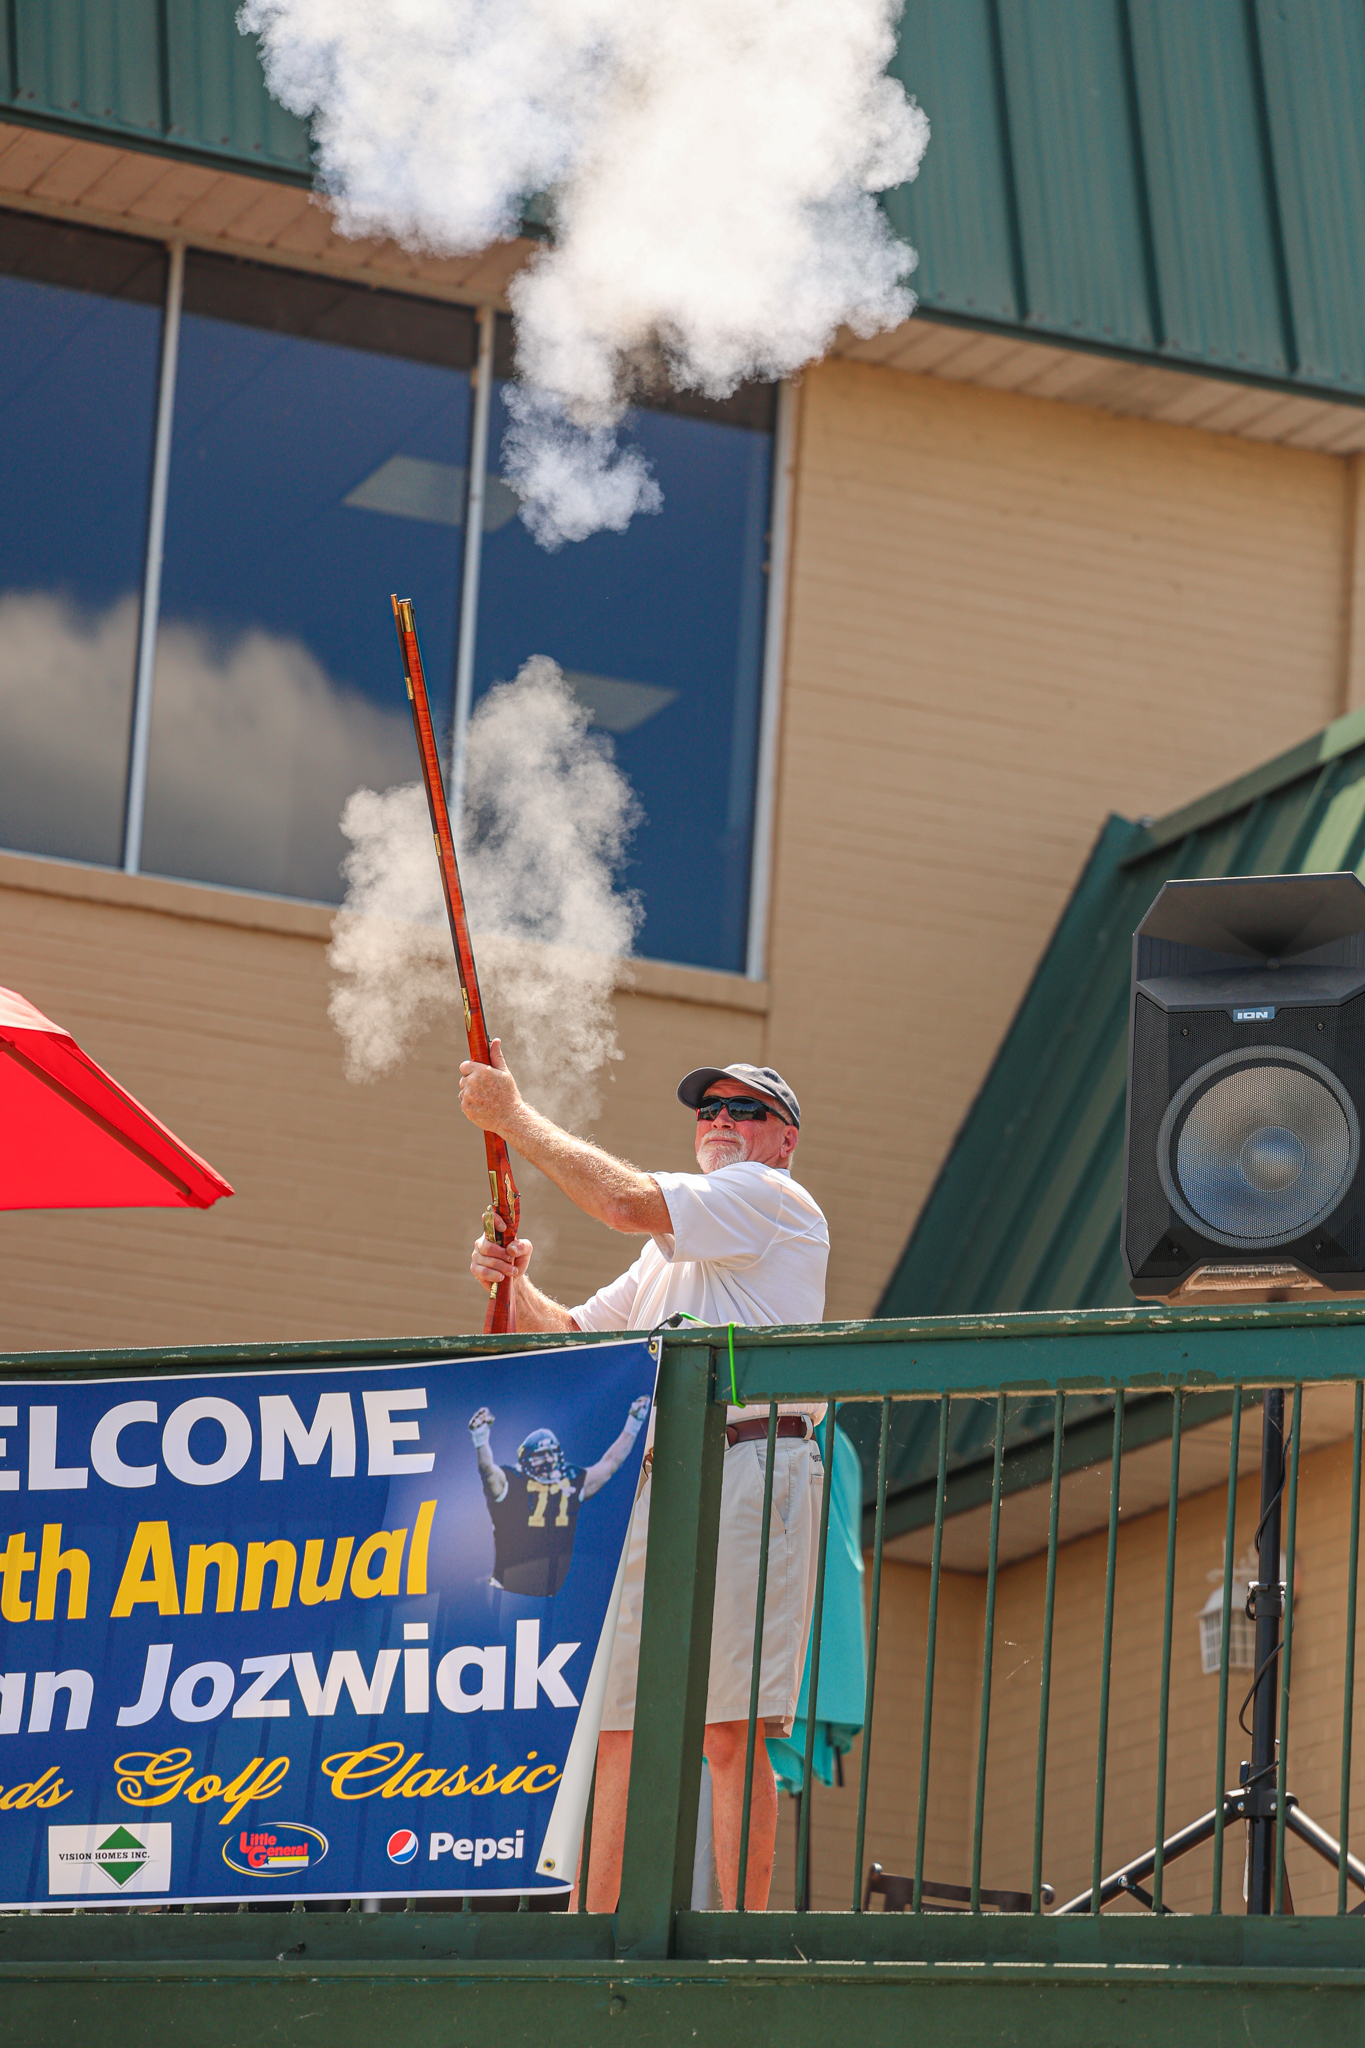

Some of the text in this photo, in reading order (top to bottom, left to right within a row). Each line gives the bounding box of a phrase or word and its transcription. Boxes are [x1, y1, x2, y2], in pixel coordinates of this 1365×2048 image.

[1237, 1011, 1268, 1020] ION
[0, 1499, 438, 1623] th Annual
[116, 1618, 582, 1727] Jozwiak
[0, 1742, 563, 1826] ds Golf Classic
[58, 1851, 150, 1861] VISION HOMES INC.
[239, 1831, 277, 1854] Little
[248, 1842, 308, 1869] General
[428, 1829, 525, 1867] Pepsi
